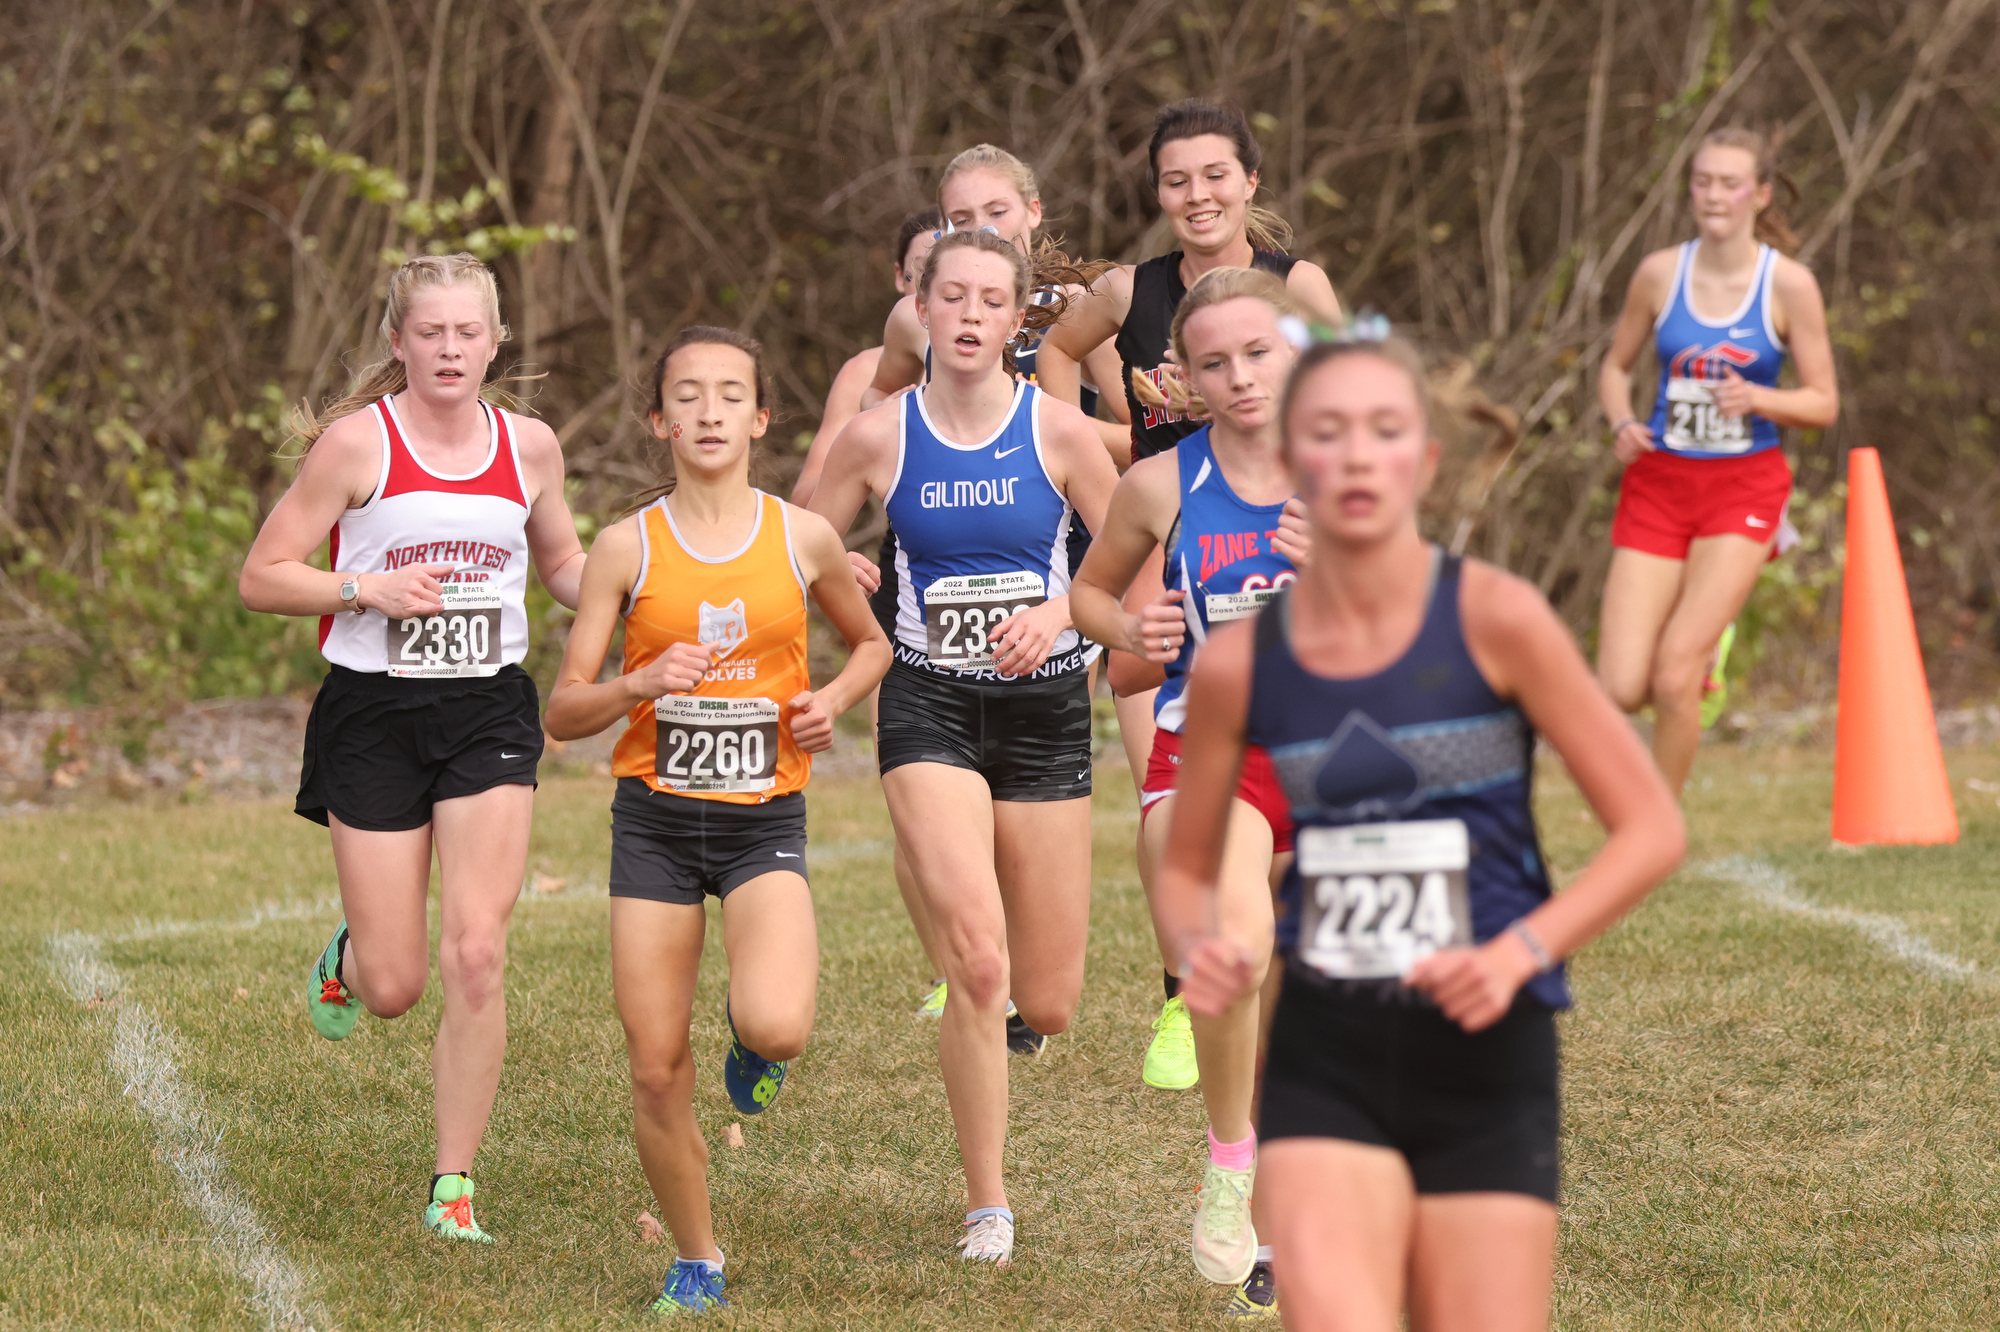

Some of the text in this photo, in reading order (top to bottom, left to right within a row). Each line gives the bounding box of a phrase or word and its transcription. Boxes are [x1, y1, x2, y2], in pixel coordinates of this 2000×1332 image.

[921, 477, 1019, 509] GILMOUR
[384, 541, 512, 573] NORTHWEST
[1198, 532, 1259, 583] ZANE
[968, 577, 997, 588] OHSAA
[1000, 576, 1025, 585] STATE
[984, 583, 1042, 595] Championships
[447, 595, 500, 603] Championships
[400, 614, 489, 661] 2330
[939, 604, 1031, 655] 233
[704, 666, 757, 682] OLVES
[1031, 651, 1081, 679] NIKE
[656, 707, 777, 720] Cross Country Championships
[673, 700, 693, 708] 2022
[699, 700, 729, 710] OHSAA
[666, 728, 766, 776] 2260
[1314, 871, 1456, 950] 2224
